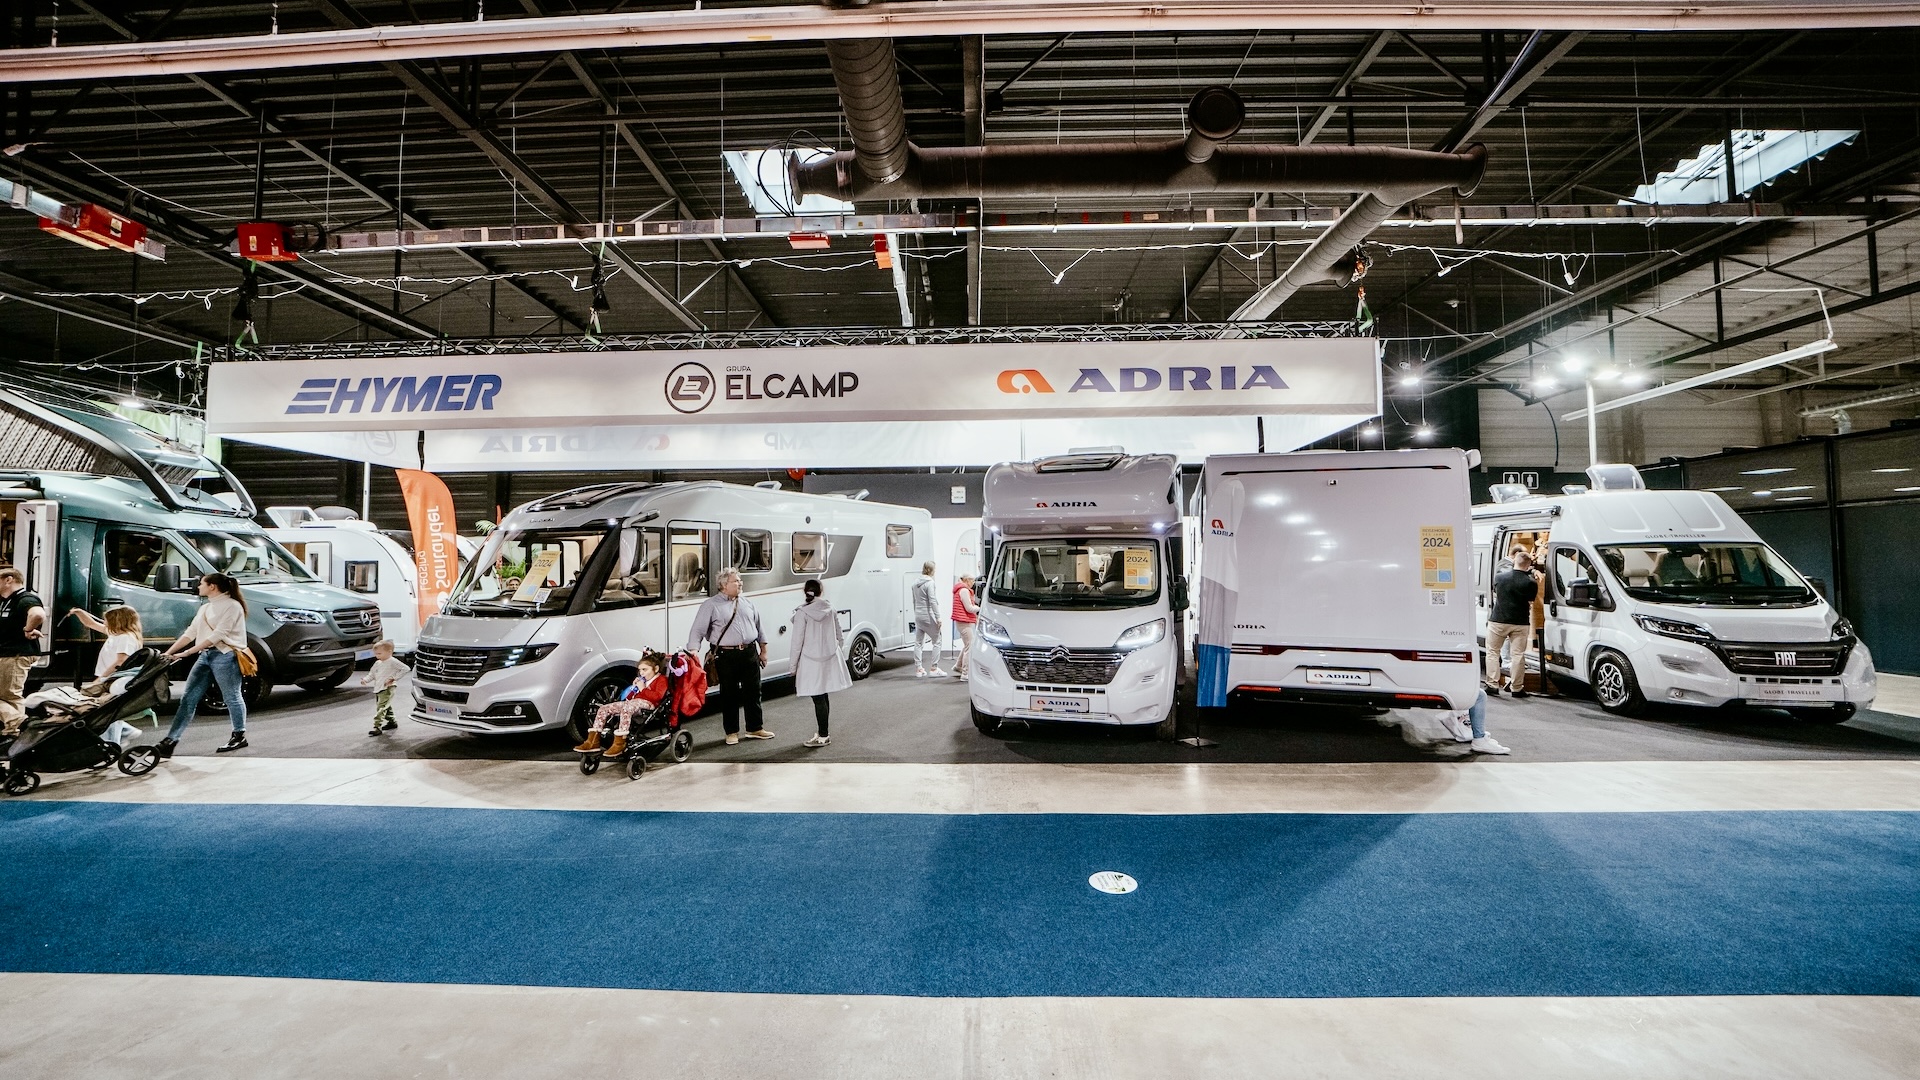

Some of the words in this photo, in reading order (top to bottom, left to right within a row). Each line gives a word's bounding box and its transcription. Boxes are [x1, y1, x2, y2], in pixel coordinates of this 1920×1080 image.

[726, 371, 859, 400] ELCAMP
[1068, 365, 1290, 393] ADRIA
[328, 374, 502, 414] HYMER
[1211, 529, 1234, 537] ADRIA
[1423, 537, 1451, 547] 2024
[1774, 652, 1796, 665] FIAT
